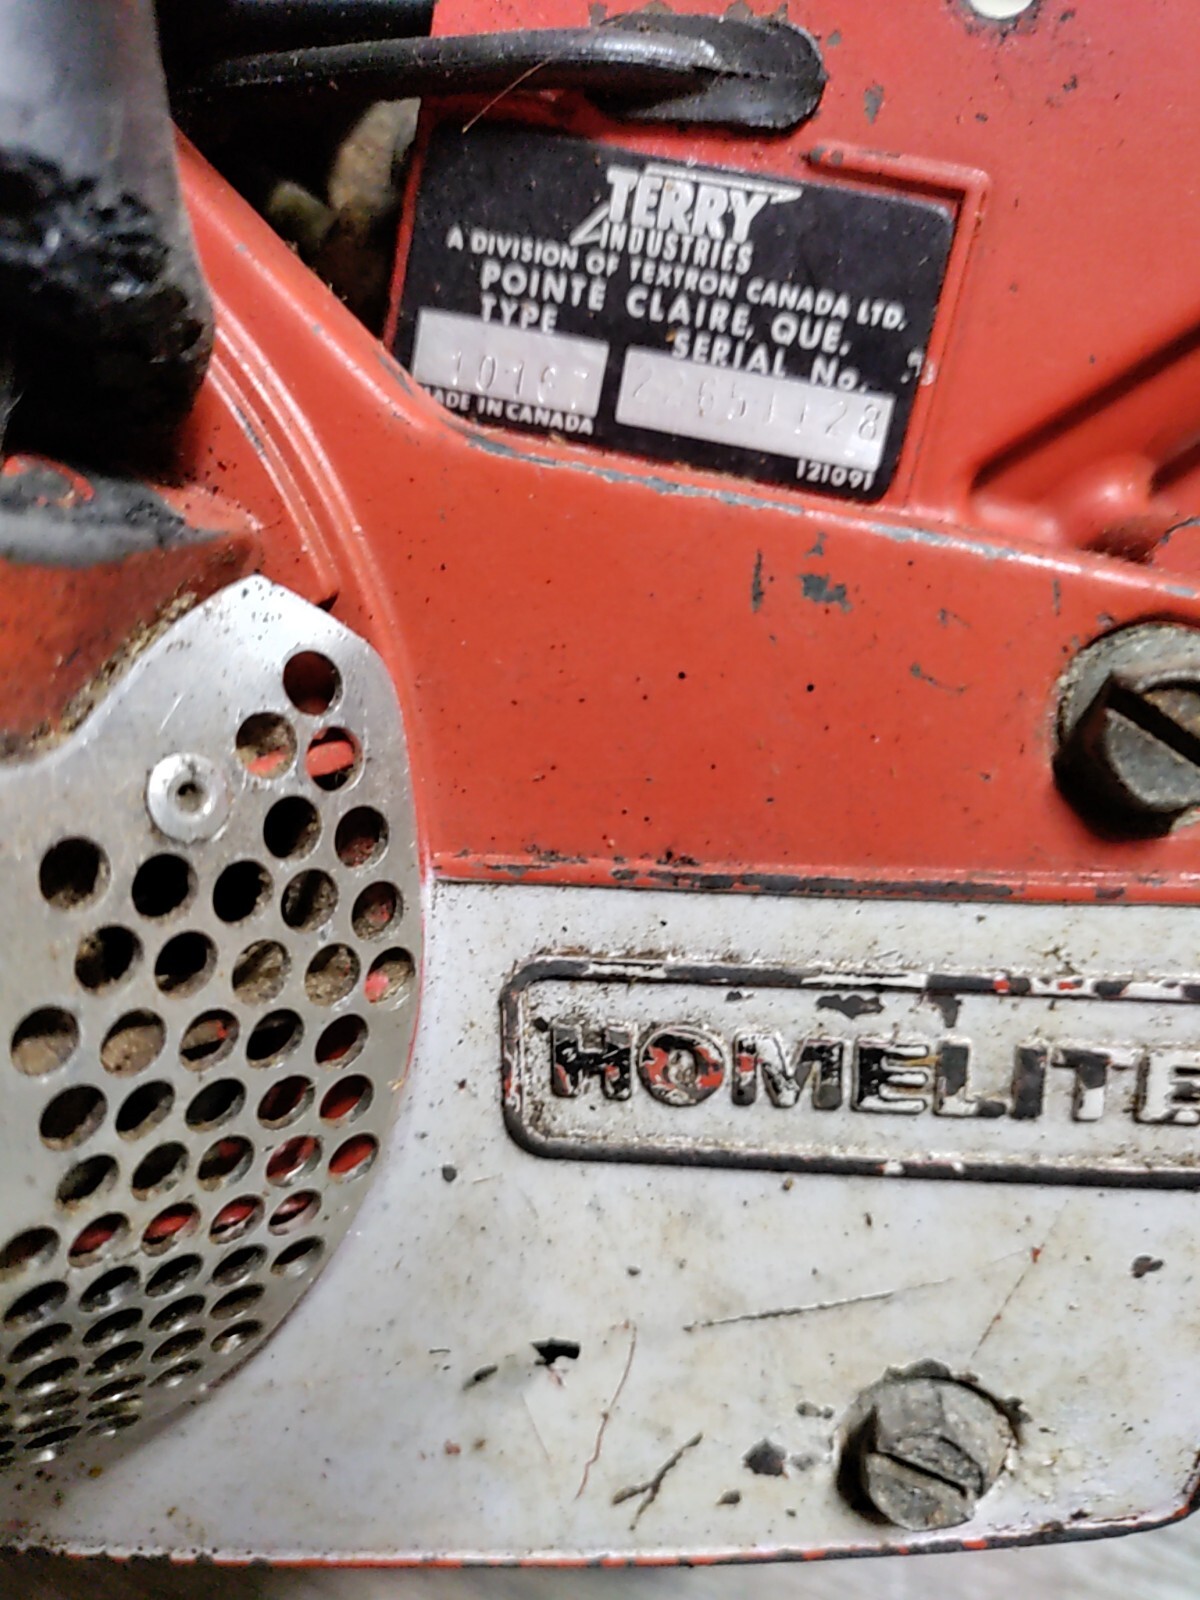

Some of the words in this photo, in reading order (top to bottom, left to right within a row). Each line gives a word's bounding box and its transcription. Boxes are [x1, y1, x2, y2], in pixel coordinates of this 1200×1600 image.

[606, 165, 762, 243] TERRY
[446, 224, 465, 251] A
[470, 228, 580, 271] DIVISION
[585, 248, 620, 278] OF
[629, 254, 740, 300] TEXTRON
[746, 276, 850, 321] CANADA
[599, 220, 753, 276] INDUSTRIES
[480, 257, 607, 312] POINTE
[626, 285, 756, 342] CLAIRE,
[480, 292, 559, 333] TYPE
[671, 325, 787, 378] SERIAL
[477, 397, 504, 419] IN
[506, 404, 594, 436] CANADA
[796, 458, 876, 492] 121091
[548, 1018, 1200, 1126] HOMELITE
